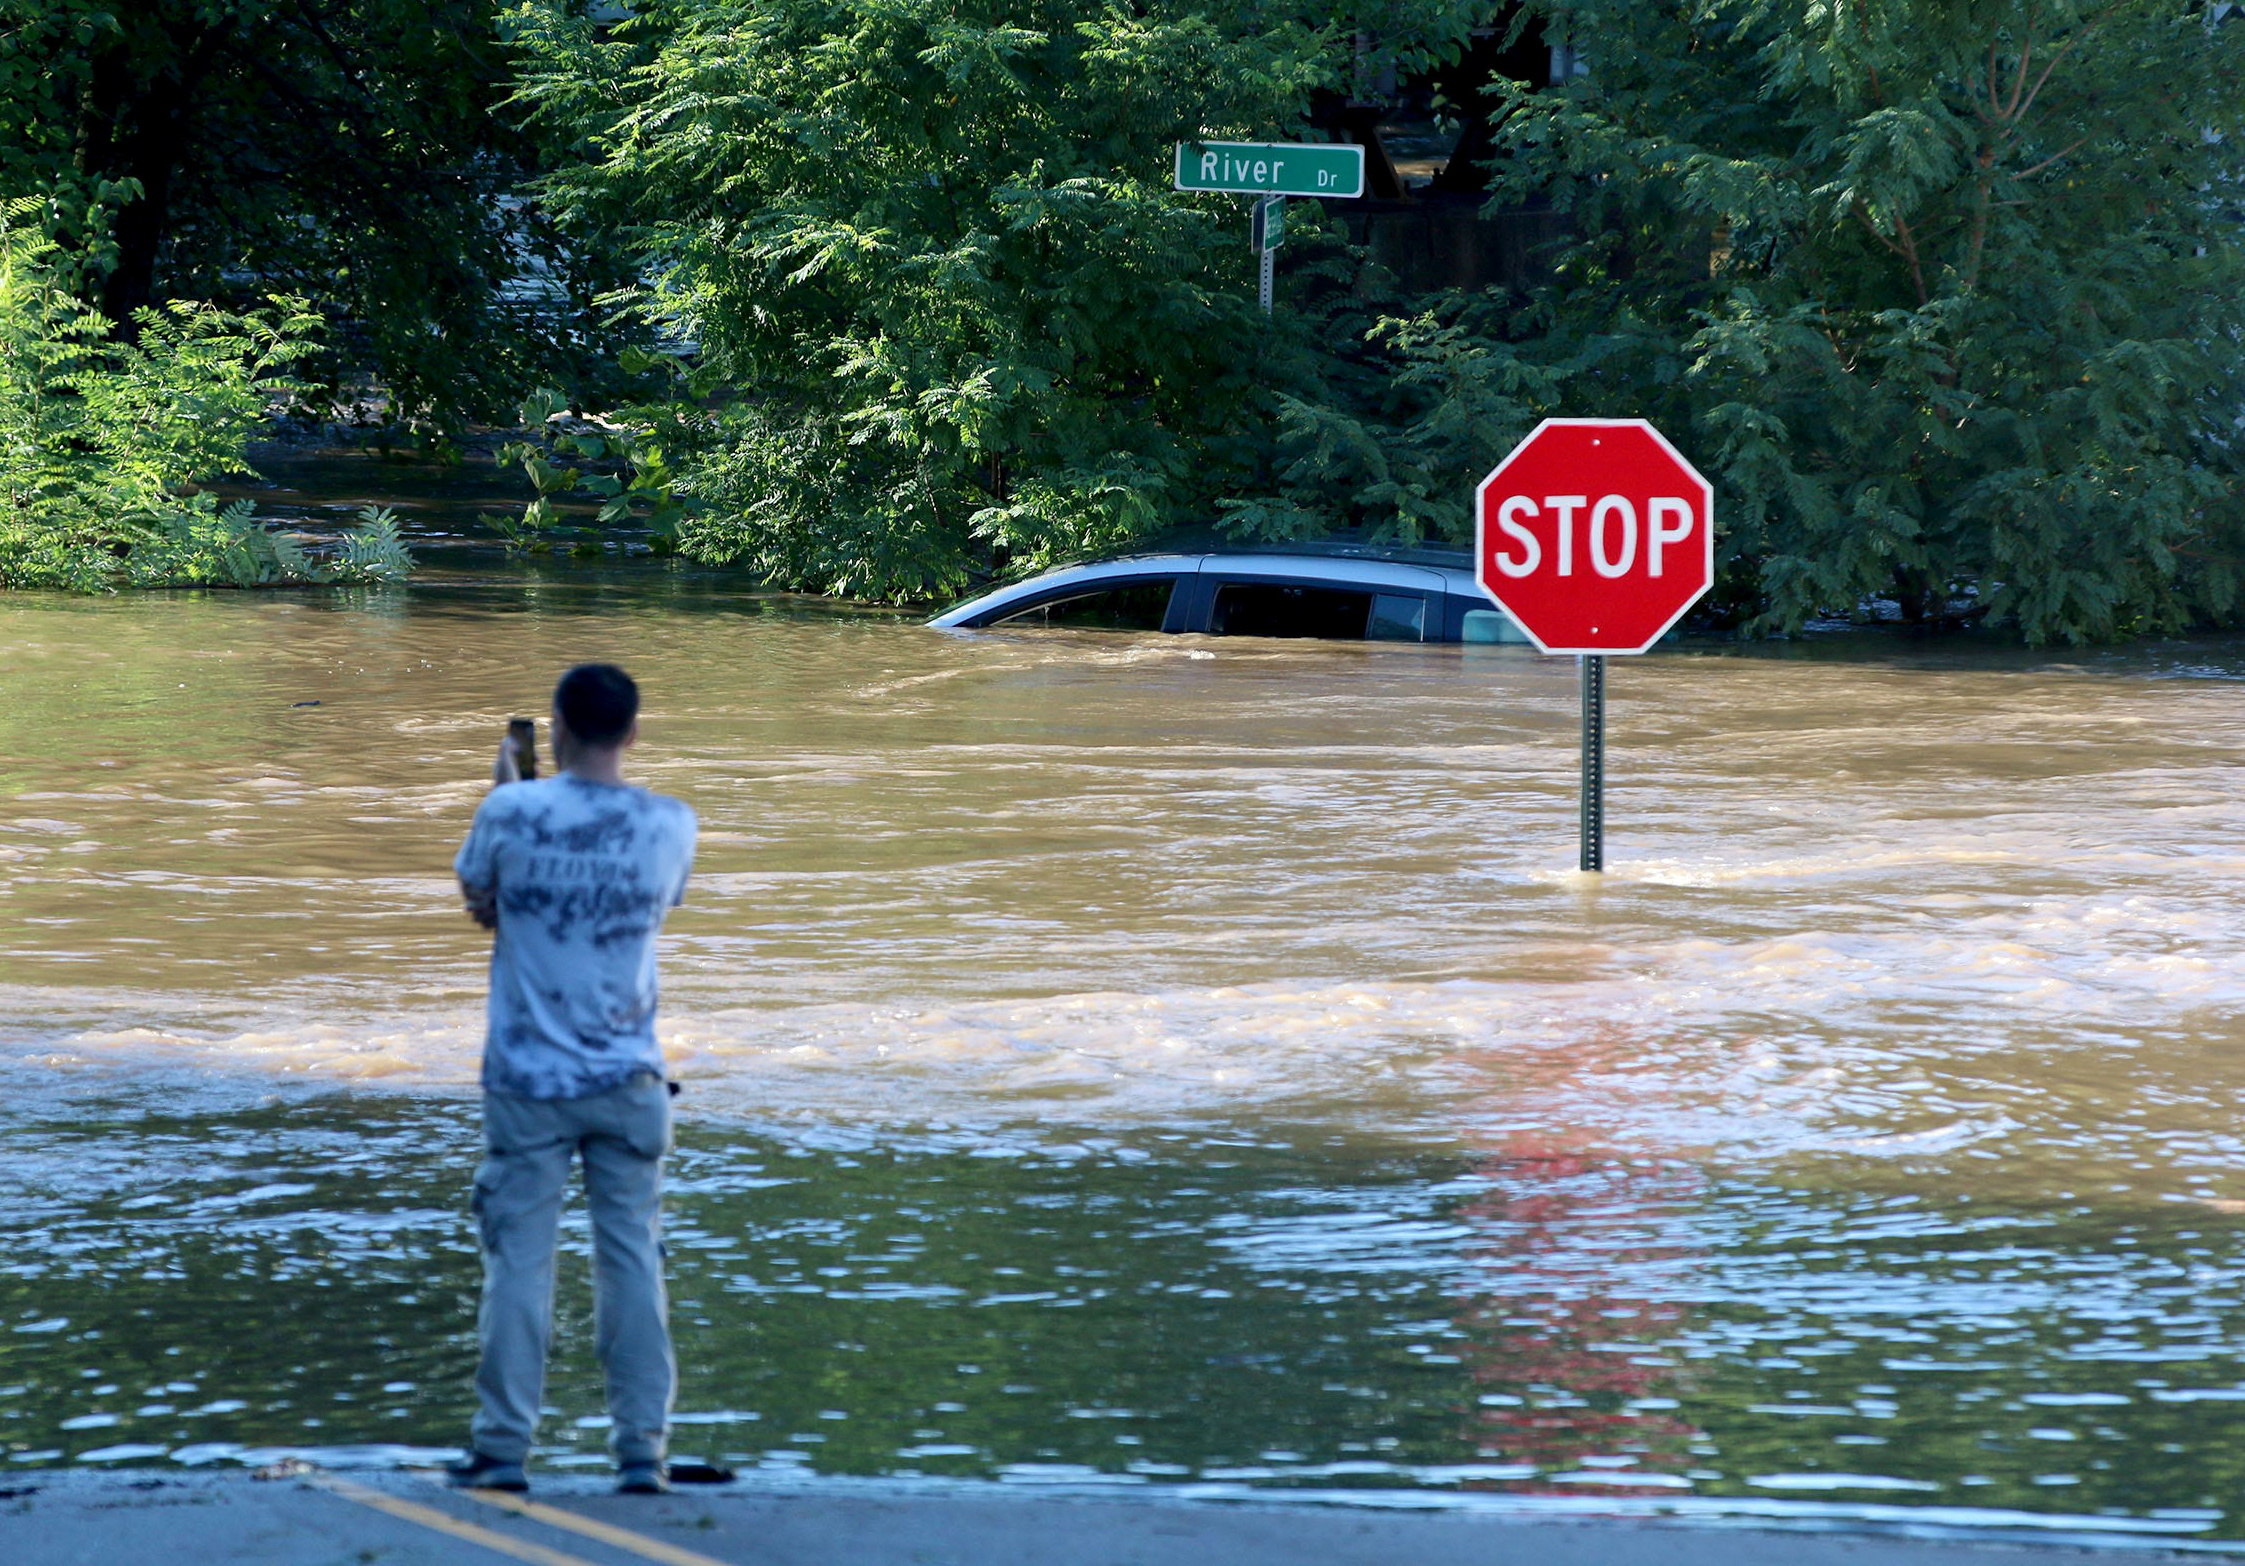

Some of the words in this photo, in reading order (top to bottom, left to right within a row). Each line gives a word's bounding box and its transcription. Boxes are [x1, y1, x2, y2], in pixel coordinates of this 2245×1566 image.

[1200, 151, 1284, 183] River
[1317, 169, 1338, 187] Dr
[1494, 494, 1694, 579] STOP
